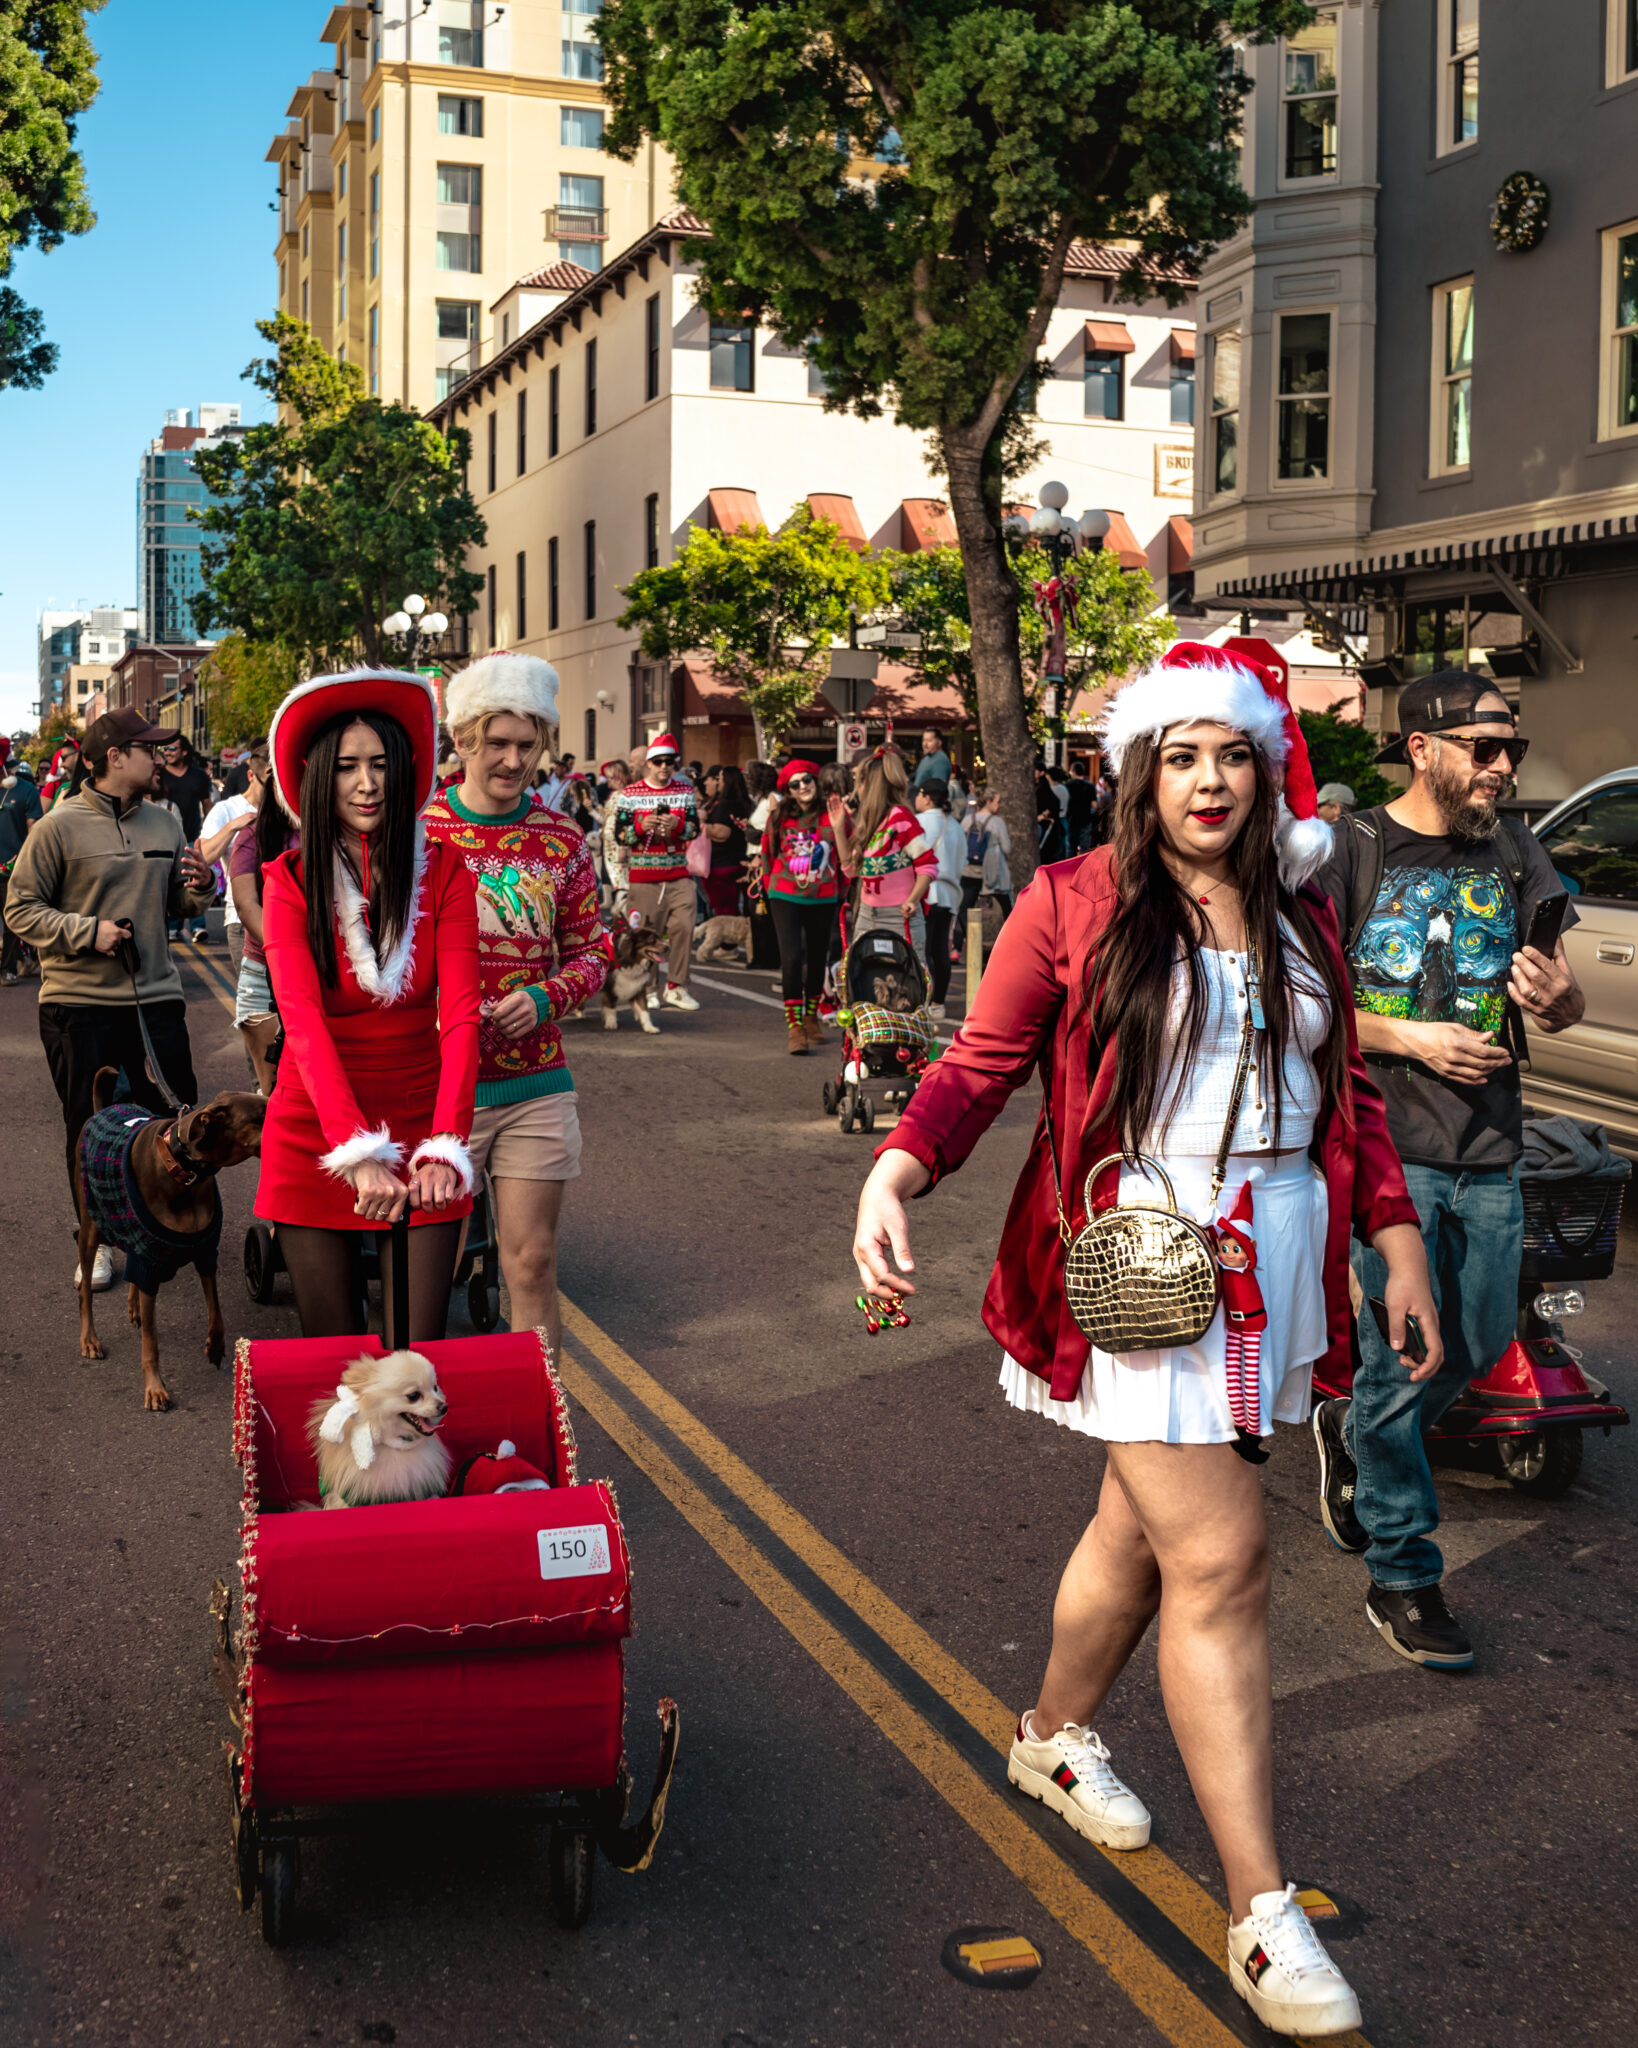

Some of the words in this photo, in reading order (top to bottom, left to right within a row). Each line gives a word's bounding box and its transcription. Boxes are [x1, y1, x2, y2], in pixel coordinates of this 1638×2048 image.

[1166, 455, 1194, 471] BRU
[641, 798, 655, 806] OH
[656, 797, 680, 805] SNAP
[549, 1539, 587, 1561] 150
